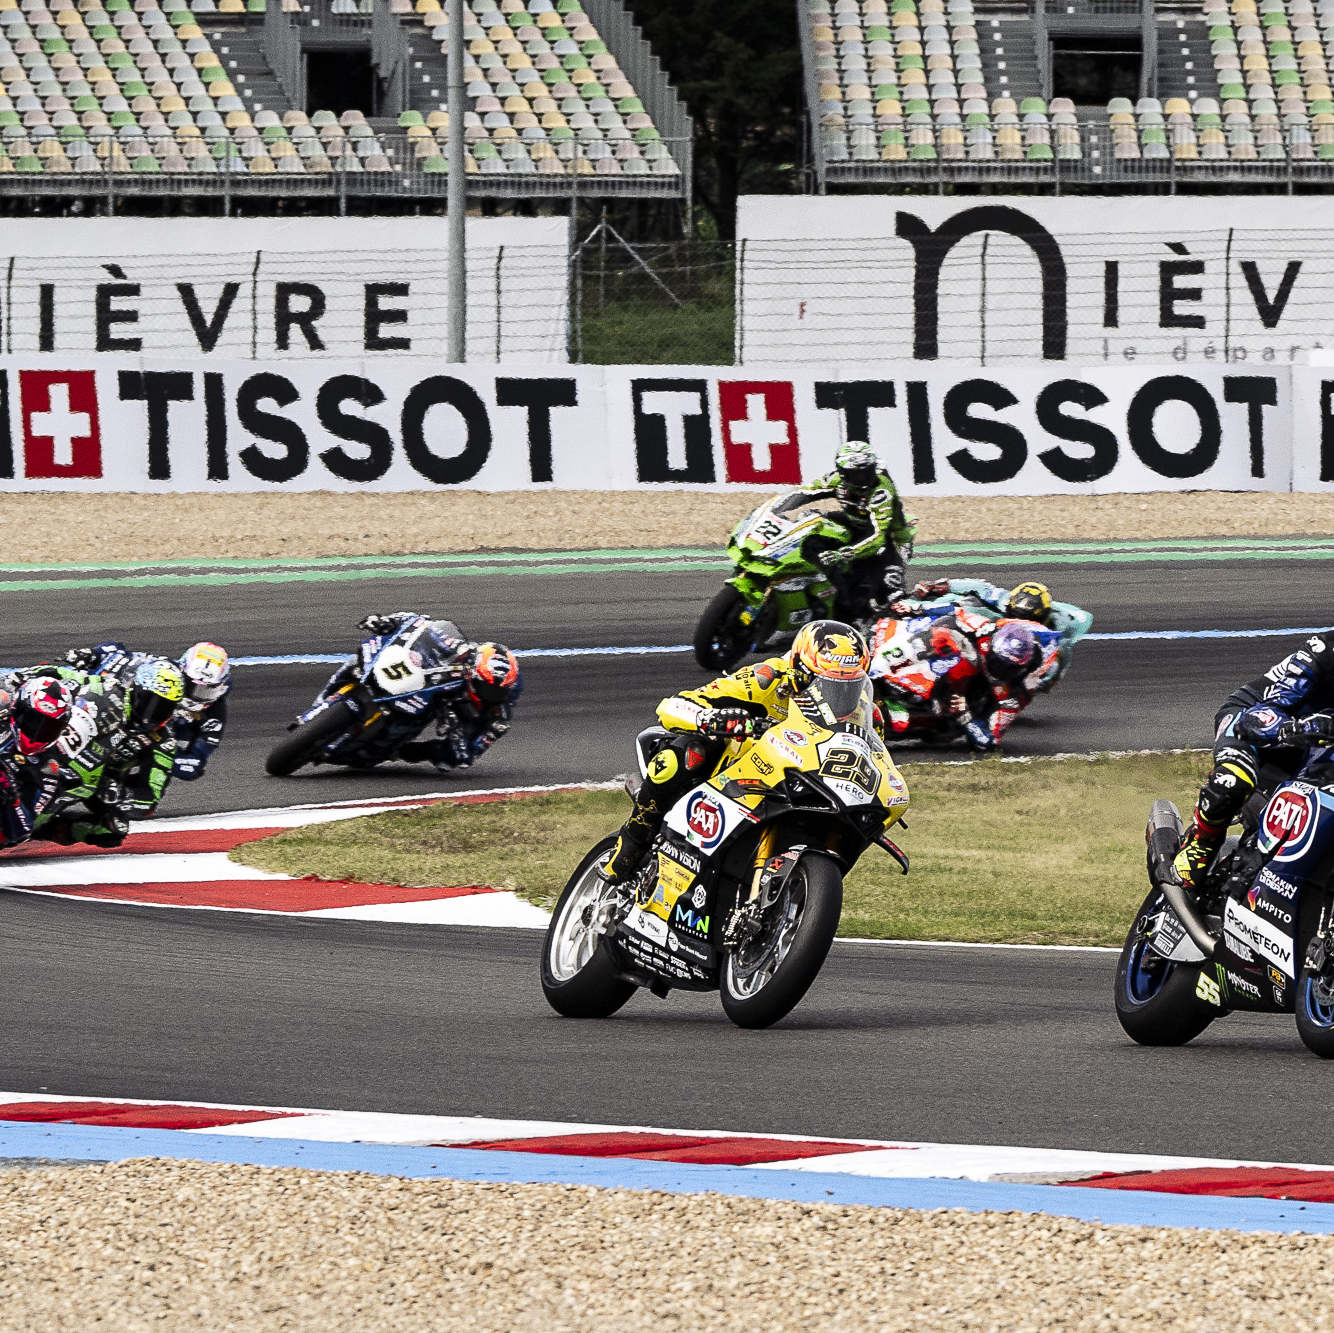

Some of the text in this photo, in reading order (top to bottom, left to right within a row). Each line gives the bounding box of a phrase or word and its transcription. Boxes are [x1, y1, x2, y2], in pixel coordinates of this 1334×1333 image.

[118, 368, 579, 485] TISSOT
[815, 374, 1278, 486] TISSOT
[380, 660, 414, 683] 5
[823, 652, 861, 667] NOLAN
[818, 747, 878, 796] 29
[835, 782, 864, 800] HERO
[1268, 796, 1304, 835] PATA
[1261, 866, 1298, 894] SEMAKIN
[1256, 896, 1292, 924] AMPITO
[1226, 907, 1291, 963] PROMETEON
[1195, 971, 1221, 1007] 55
